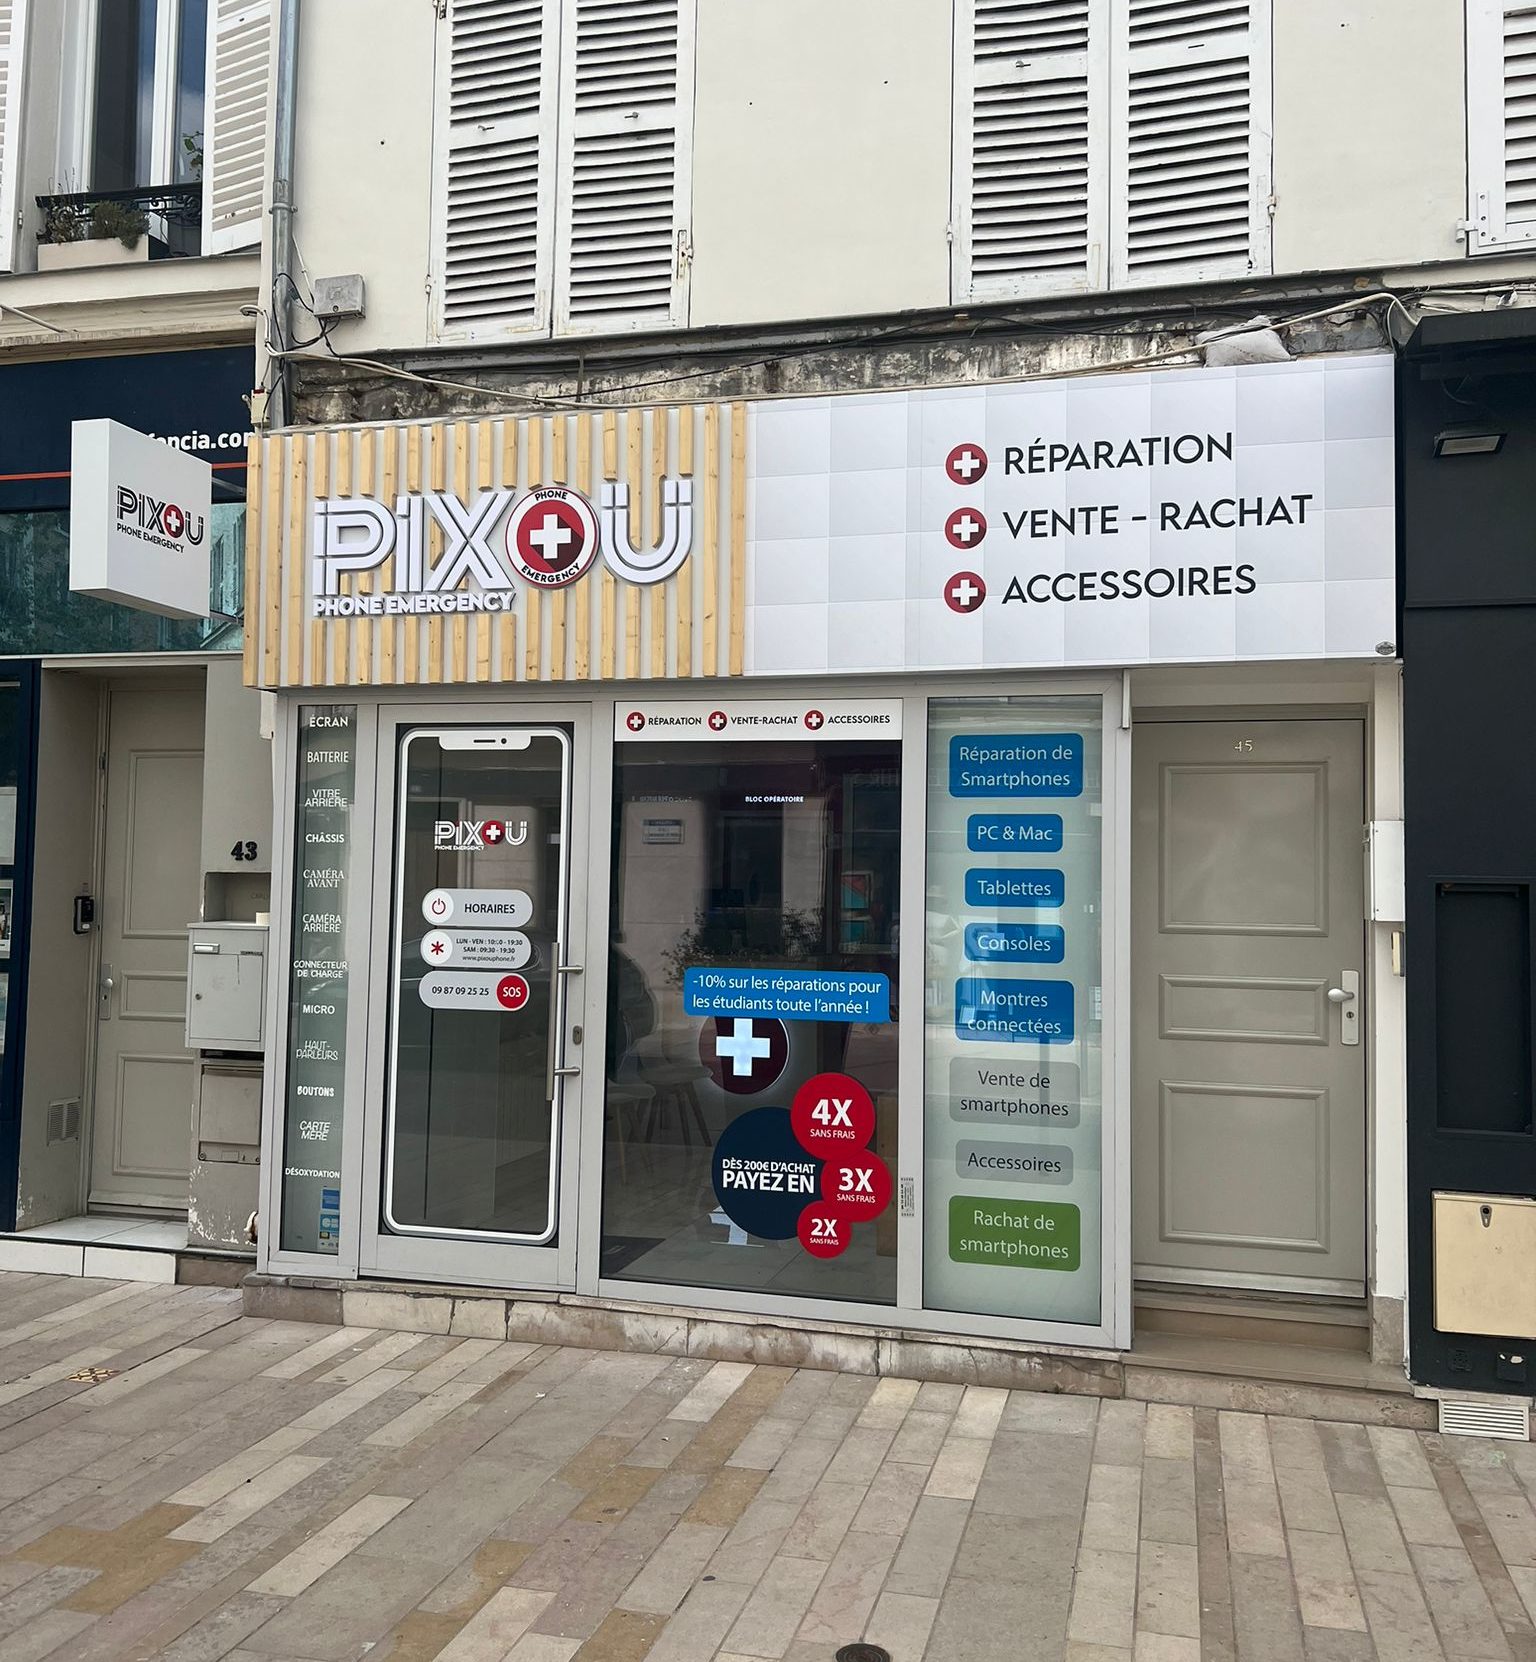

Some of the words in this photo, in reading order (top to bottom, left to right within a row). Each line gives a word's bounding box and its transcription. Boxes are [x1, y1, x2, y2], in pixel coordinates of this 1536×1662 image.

[1003, 432, 1233, 476] RÉPARATION
[535, 490, 568, 501] PHONE
[1003, 505, 1119, 539] VENTE
[1160, 494, 1313, 531] RACHAT
[117, 523, 142, 540] PHONE
[143, 533, 185, 553] EMERGENCY
[521, 562, 580, 583] EMERGENCY
[1001, 564, 1257, 605] ACCESSOIRES
[313, 595, 384, 617] PHONE
[385, 592, 516, 615] EMERGENCY
[309, 714, 349, 728] ÉCRAN
[648, 714, 702, 726] RÉPARATION
[731, 715, 798, 725] VENTE-RACHAT
[828, 715, 890, 724] ACCESSOIRES
[1234, 739, 1253, 752] 45
[307, 751, 349, 763] BATTERIE
[959, 746, 1047, 764] Réparation
[1052, 745, 1073, 760] de
[961, 771, 1070, 789] Smartphones
[312, 789, 341, 798] VITRE
[764, 794, 804, 803] OPÉRATOIRE
[305, 832, 345, 843] CHÂSSIS
[977, 826, 998, 841] PC
[1002, 826, 1015, 840] &
[1019, 826, 1053, 841] Mac
[231, 841, 258, 861] 43
[303, 868, 344, 879] CAMÉRA
[307, 879, 340, 888] AVANT
[977, 879, 1051, 896] Tablettes
[464, 903, 516, 914] HORAIRES
[303, 913, 342, 924] CAMÉRA
[977, 935, 1051, 951] Consoles
[293, 960, 348, 970] CONNECTEUR
[297, 969, 308, 977] DE
[310, 970, 344, 978] CHARGE
[431, 986, 442, 995] 09
[443, 986, 455, 995] 87
[455, 987, 466, 995] 09
[467, 987, 478, 995] 25
[479, 987, 489, 996] 25
[502, 986, 522, 997] SOS
[693, 974, 727, 989] -10%
[729, 978, 749, 989] sur
[751, 975, 769, 990] les
[771, 976, 846, 994] réparations
[848, 981, 882, 998] pour
[693, 993, 710, 1008] les
[713, 995, 773, 1011] étudiants
[776, 998, 811, 1012] toute
[981, 990, 1048, 1007] Montres
[303, 1005, 335, 1014] MICRO
[967, 1018, 1062, 1034] connectées
[296, 1049, 339, 1060] PARLEURS
[978, 1070, 1025, 1087] Vente
[1030, 1072, 1051, 1088] de
[297, 1086, 335, 1097] BOUTONS
[811, 1098, 853, 1127] 4X
[960, 1097, 1069, 1118] smartphones
[299, 1120, 331, 1132] CARTE
[810, 1128, 832, 1139] SANS
[832, 1129, 855, 1140] FRAIS
[722, 1157, 742, 1169] DÈS
[744, 1160, 769, 1171] 200€
[771, 1161, 816, 1174] D'ACHAT
[967, 1152, 1062, 1173] Accessoires
[285, 1167, 341, 1179] DÉSOXYDATION
[838, 1167, 874, 1193] 3X
[722, 1170, 783, 1192] PAYEZ
[788, 1174, 815, 1194] EN
[836, 1193, 854, 1202] SANS
[856, 1194, 876, 1204] FRAIS
[974, 1210, 1029, 1229] Rachat
[1034, 1213, 1055, 1231] de
[811, 1218, 838, 1238] 2X
[810, 1237, 824, 1245] SANS
[824, 1238, 839, 1246] FRAIS
[960, 1236, 1069, 1260] smartphones
